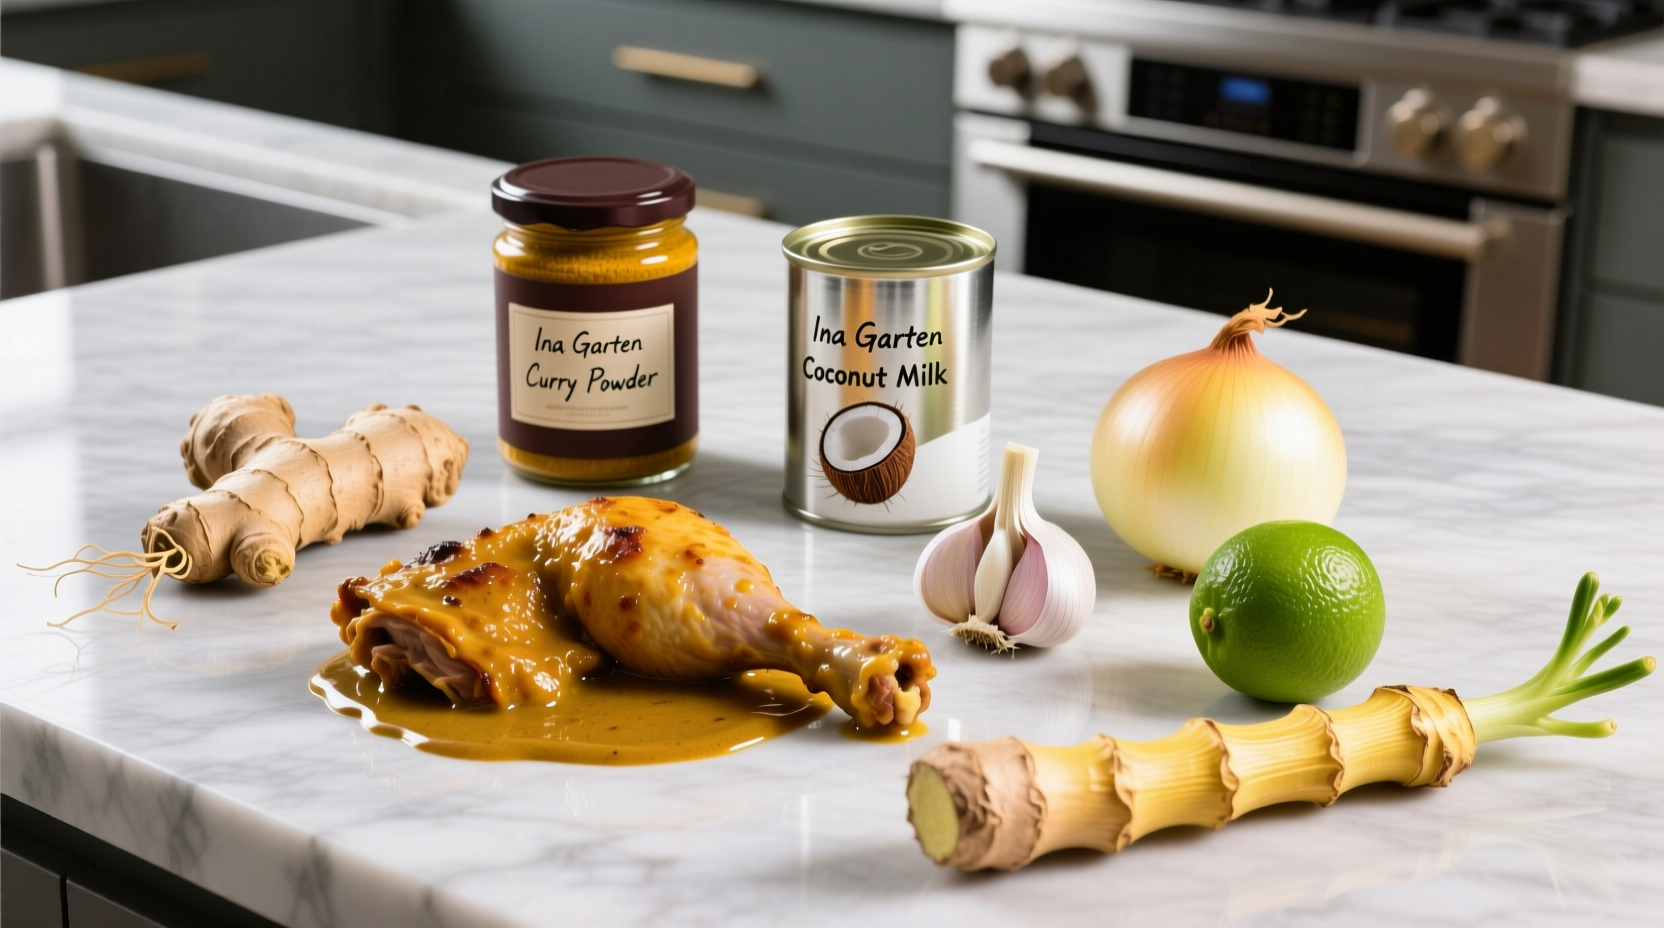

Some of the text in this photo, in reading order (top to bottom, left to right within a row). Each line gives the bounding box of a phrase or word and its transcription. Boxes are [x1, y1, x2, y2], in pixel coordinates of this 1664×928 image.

[534, 326, 643, 359] Ina Garten
[813, 315, 943, 353] Ina Garten
[526, 362, 659, 402] Curry Powder
[803, 356, 948, 388] Coconut Milk
